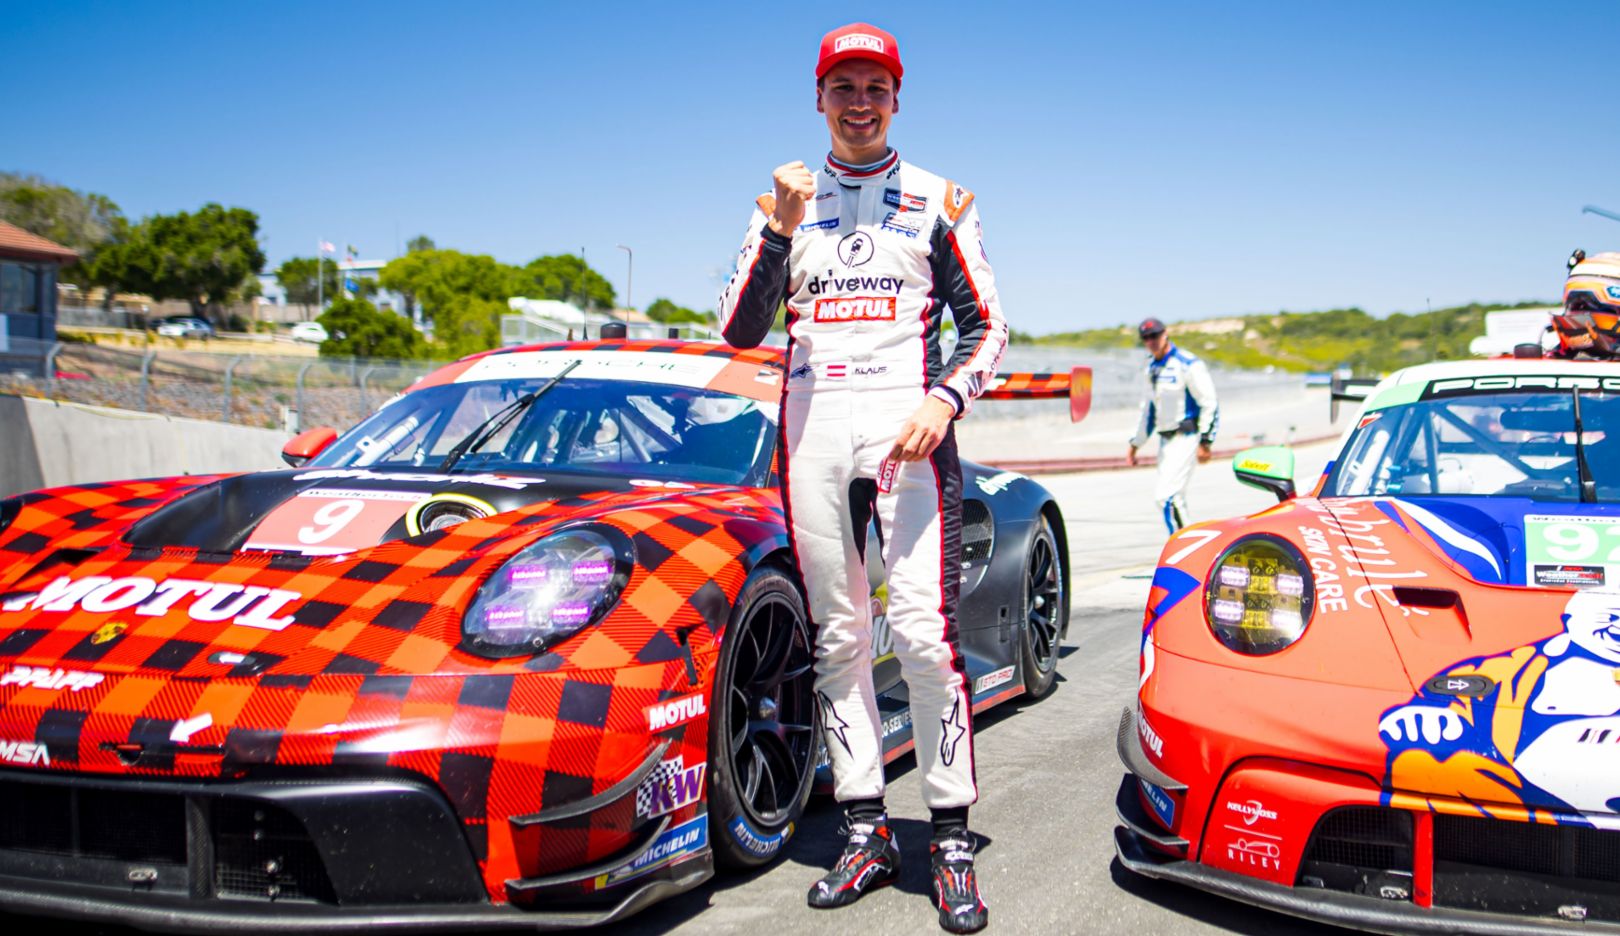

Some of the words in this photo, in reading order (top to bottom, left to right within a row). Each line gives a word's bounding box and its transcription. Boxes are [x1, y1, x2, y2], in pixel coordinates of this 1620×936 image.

[838, 36, 881, 50] MOTUL
[808, 269, 904, 295] driveway
[817, 299, 892, 319] MOTUL
[855, 366, 887, 375] KLAUS
[297, 499, 365, 544] 9
[1298, 525, 1332, 556] SKIN
[1543, 523, 1620, 561] 9
[1310, 557, 1349, 614] CARE
[2, 576, 302, 631] MOTUL
[0, 665, 105, 692] PFAFF
[650, 694, 706, 730] MOTUL
[650, 765, 705, 817] KW
[634, 827, 700, 867] MICHELIN
[734, 822, 781, 854] MICHELIN
[1228, 848, 1280, 870] RILEY
